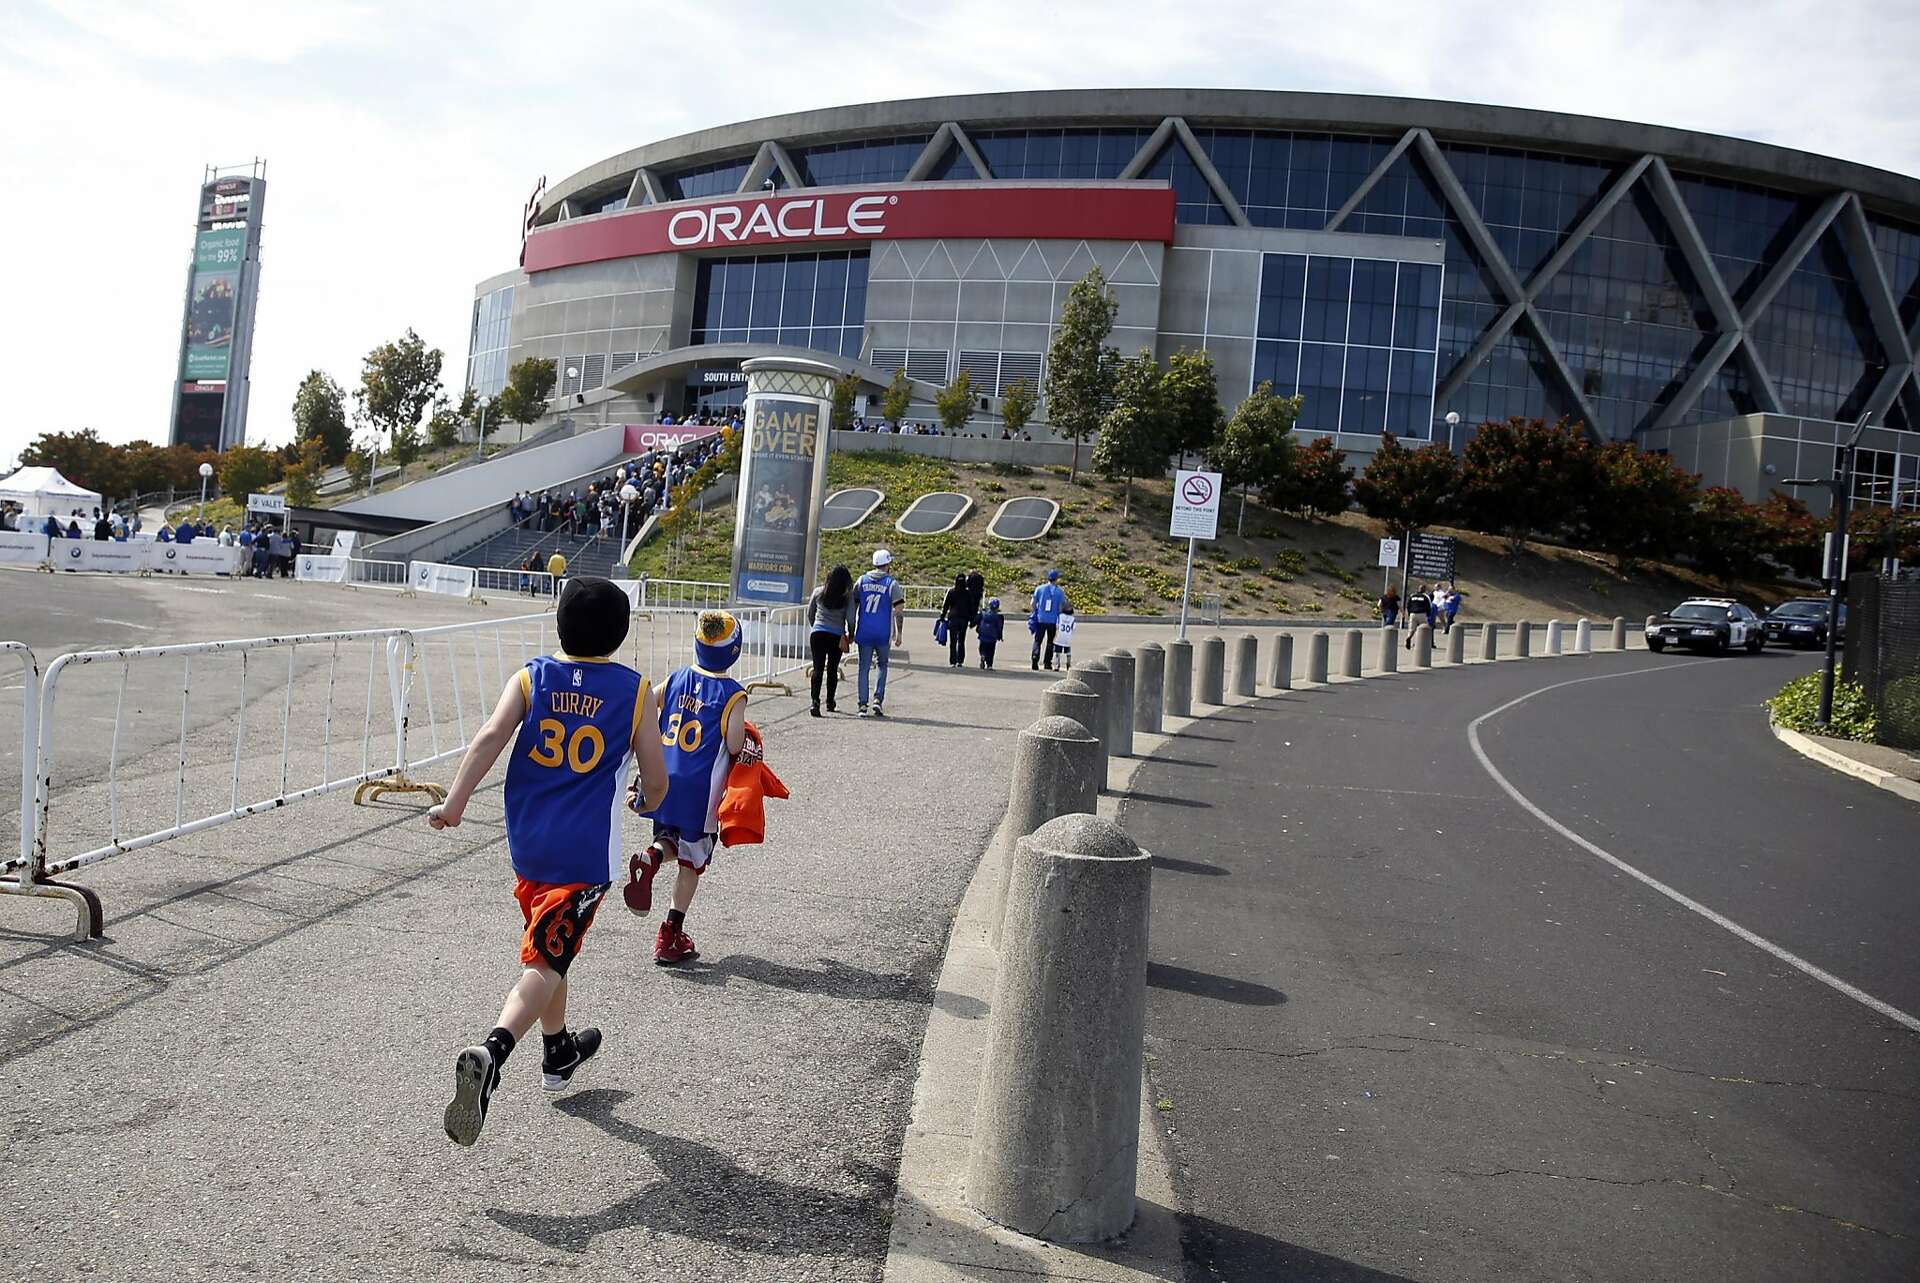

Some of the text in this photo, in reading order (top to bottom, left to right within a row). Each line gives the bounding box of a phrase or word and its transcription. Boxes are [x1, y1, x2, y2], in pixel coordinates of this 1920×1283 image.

[668, 195, 888, 246] ORACLE
[217, 249, 238, 263] 99%
[703, 372, 729, 382] SOUTH
[753, 410, 817, 434] GAME
[751, 430, 814, 456] OVER
[261, 500, 282, 508] VALET
[861, 582, 887, 595] THOMPSON
[864, 594, 881, 614] 11
[1060, 623, 1071, 633] 30
[551, 691, 604, 719] CURRY
[662, 712, 702, 753] 30
[528, 719, 605, 774] 30
